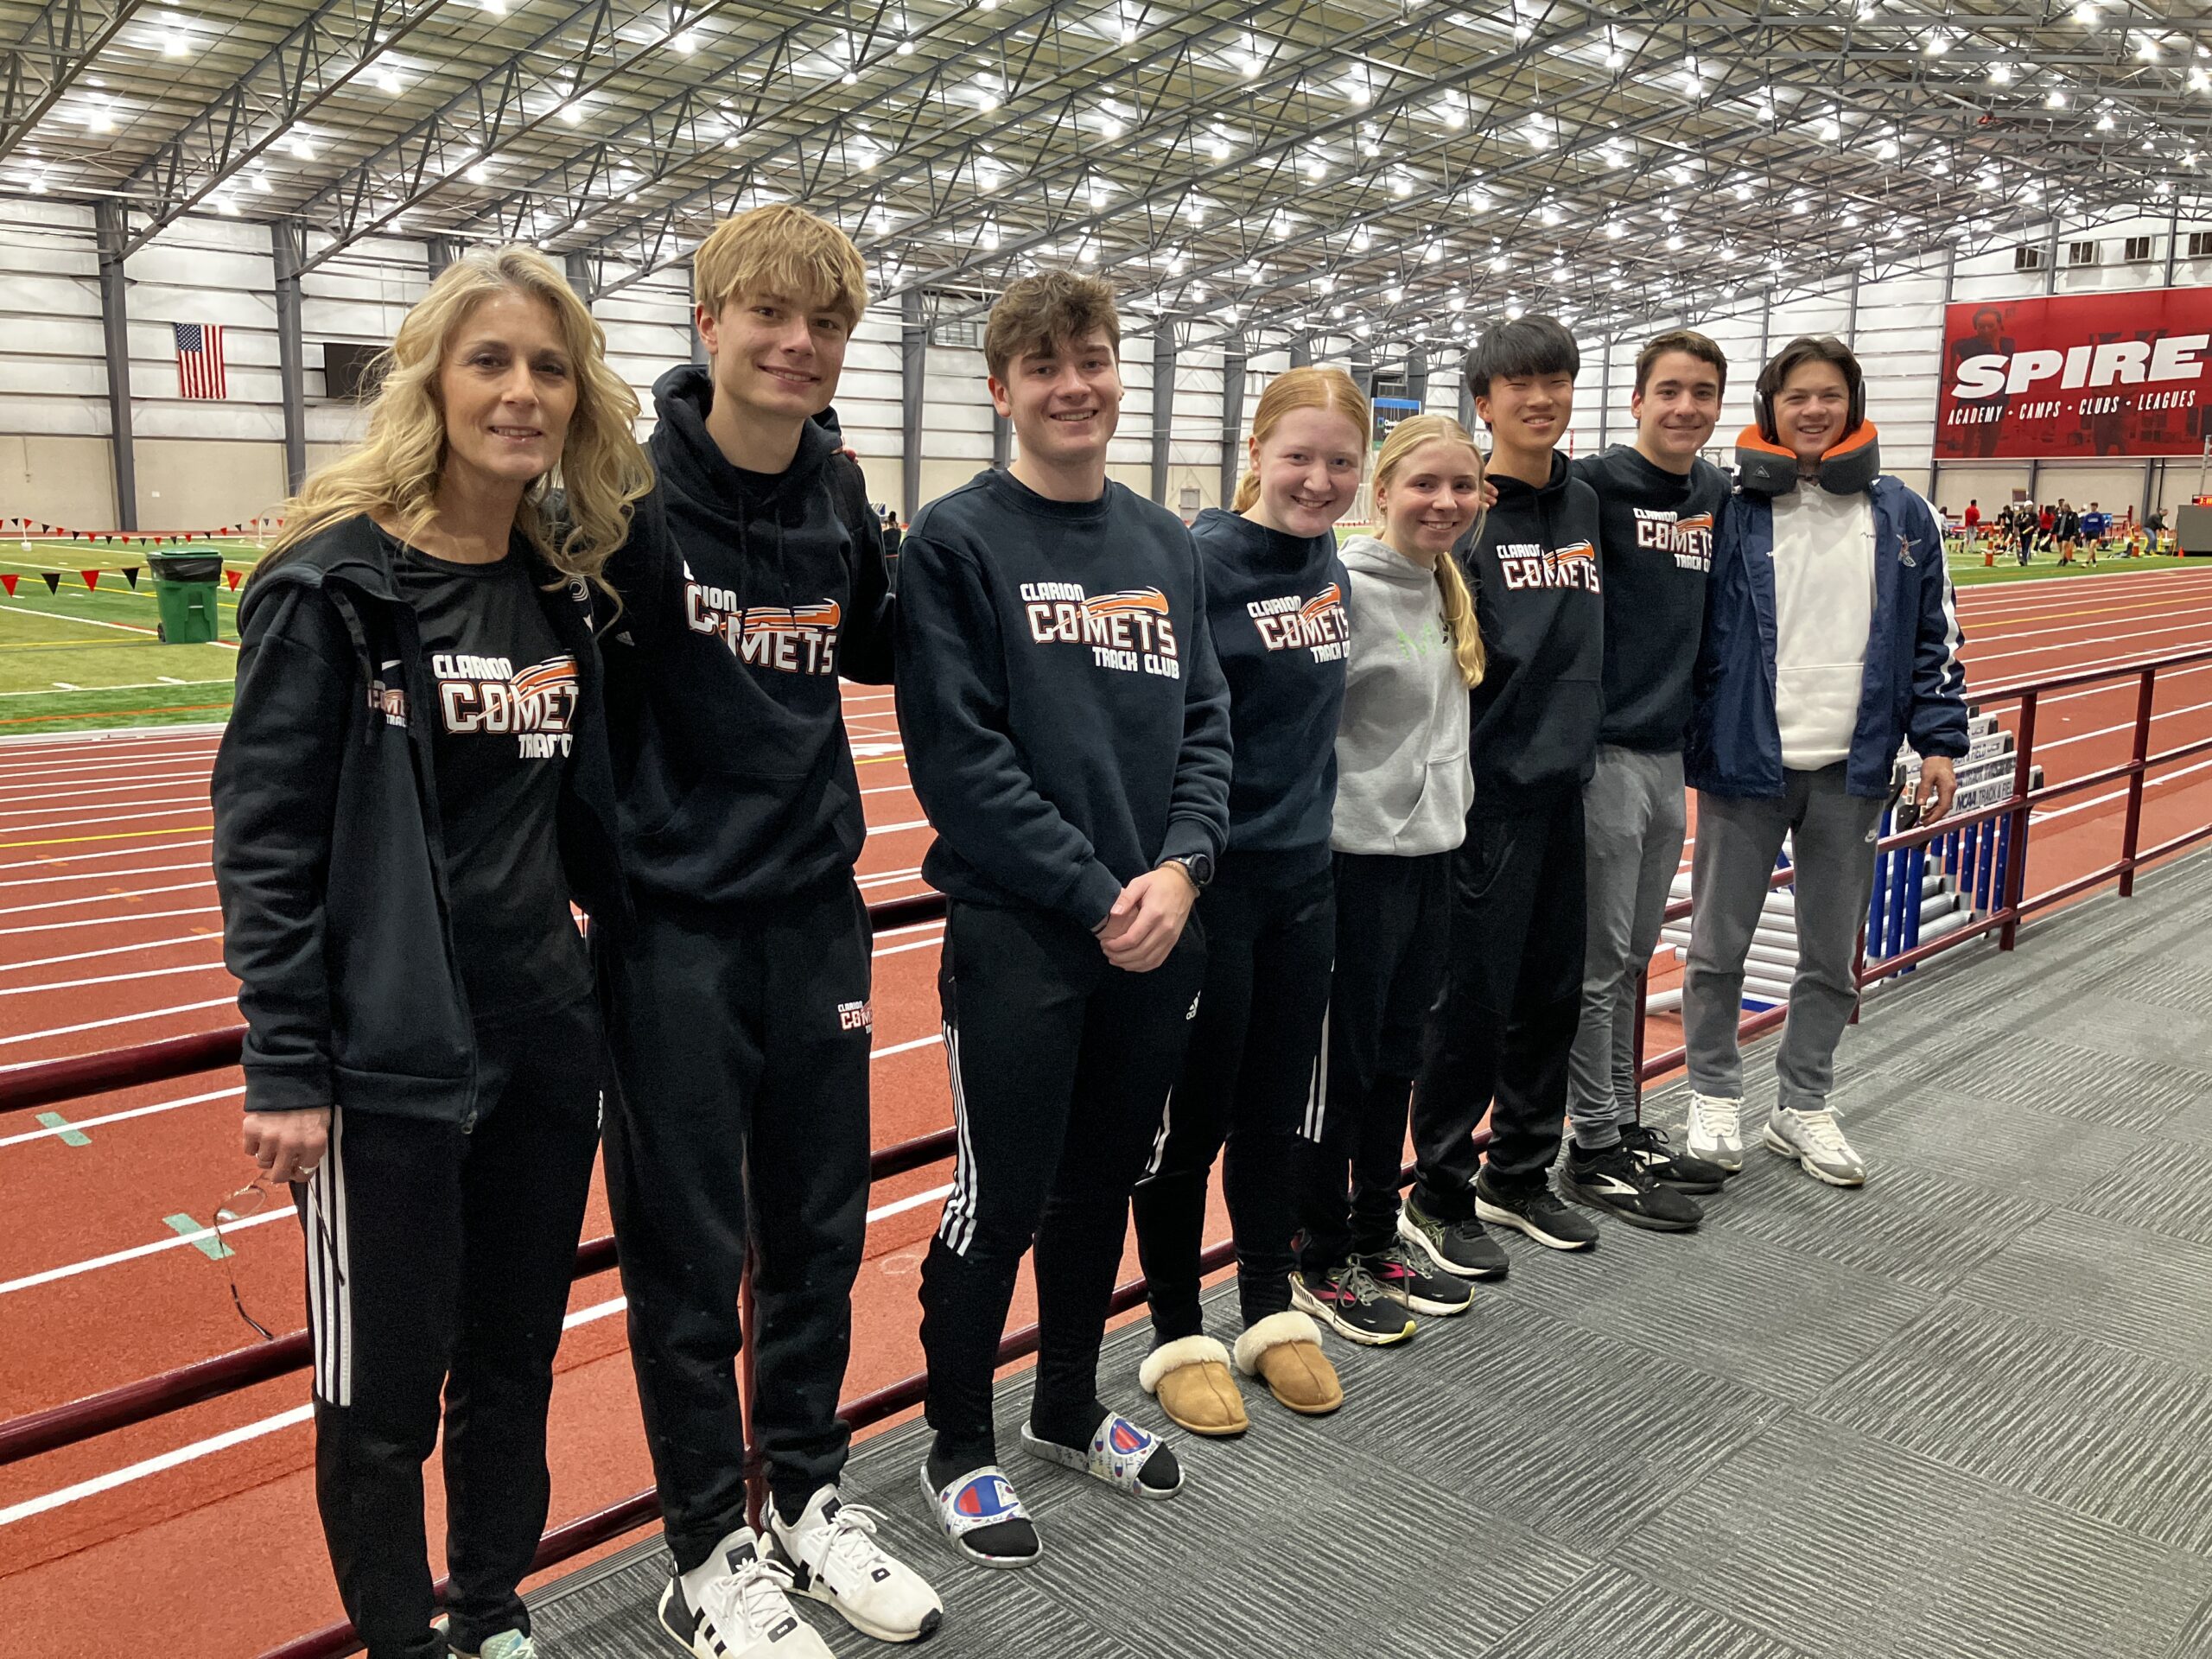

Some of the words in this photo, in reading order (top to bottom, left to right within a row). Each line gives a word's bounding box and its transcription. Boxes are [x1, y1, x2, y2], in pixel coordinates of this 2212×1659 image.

[1951, 334, 2210, 399] SPIRE
[1947, 405, 2003, 425] ACADEMY
[2018, 400, 2062, 420] CAMPS
[2078, 395, 2120, 416] CLUBS
[2137, 389, 2196, 411] LEAGUES
[1632, 507, 1678, 523] CLARION
[1501, 557, 1601, 594] COMETS
[1674, 553, 1702, 571] TRACK
[1020, 582, 1085, 602] CLARION
[1246, 595, 1302, 619] CLARION
[1026, 601, 1179, 658] COMETS
[432, 654, 513, 680] CLARION
[1091, 645, 1140, 672] TRACK
[1143, 654, 1180, 680] CLUB
[1310, 643, 1342, 664] TRACK
[438, 680, 579, 734] COMET
[1955, 790, 1978, 811] NCAA
[1979, 784, 1997, 805] TRACK
[2001, 780, 2013, 798] FIEL
[837, 1000, 863, 1013] CLARION
